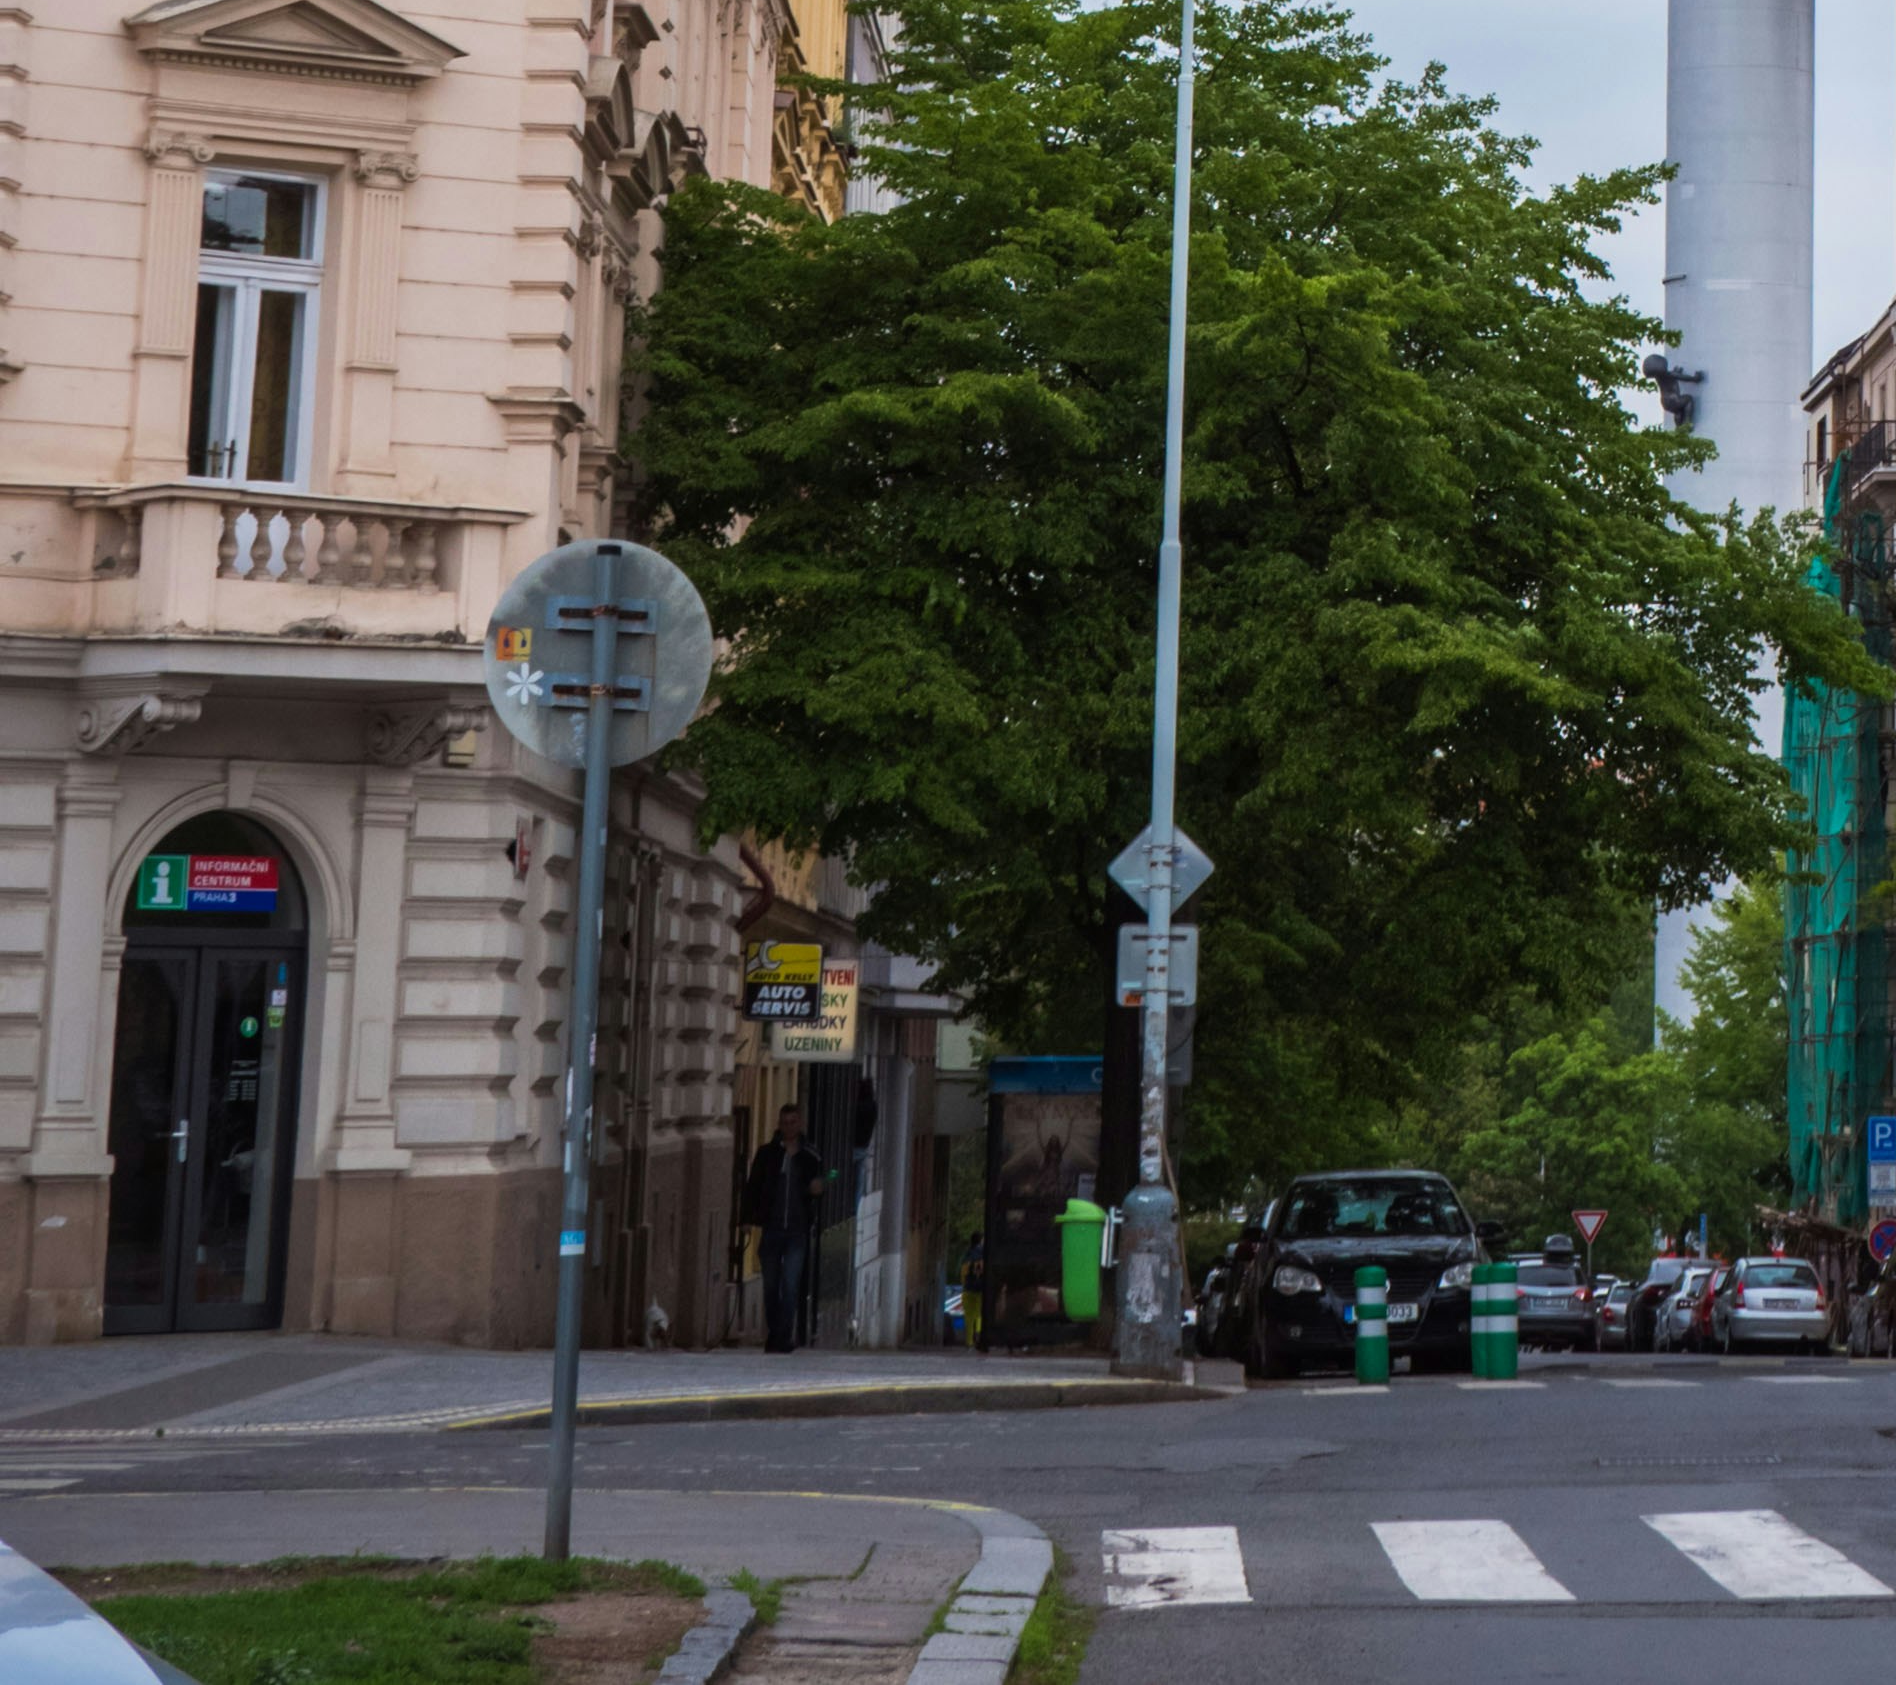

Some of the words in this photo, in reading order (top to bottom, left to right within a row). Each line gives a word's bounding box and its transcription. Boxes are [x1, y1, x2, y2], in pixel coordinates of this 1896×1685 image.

[195, 859, 269, 873] INFORMAČNÍ
[194, 876, 251, 887] CENTRUM
[757, 985, 806, 999] AUTO
[750, 1001, 811, 1015] SERVIS
[784, 1037, 842, 1051] UZENINY
[1875, 1122, 1892, 1148] P
